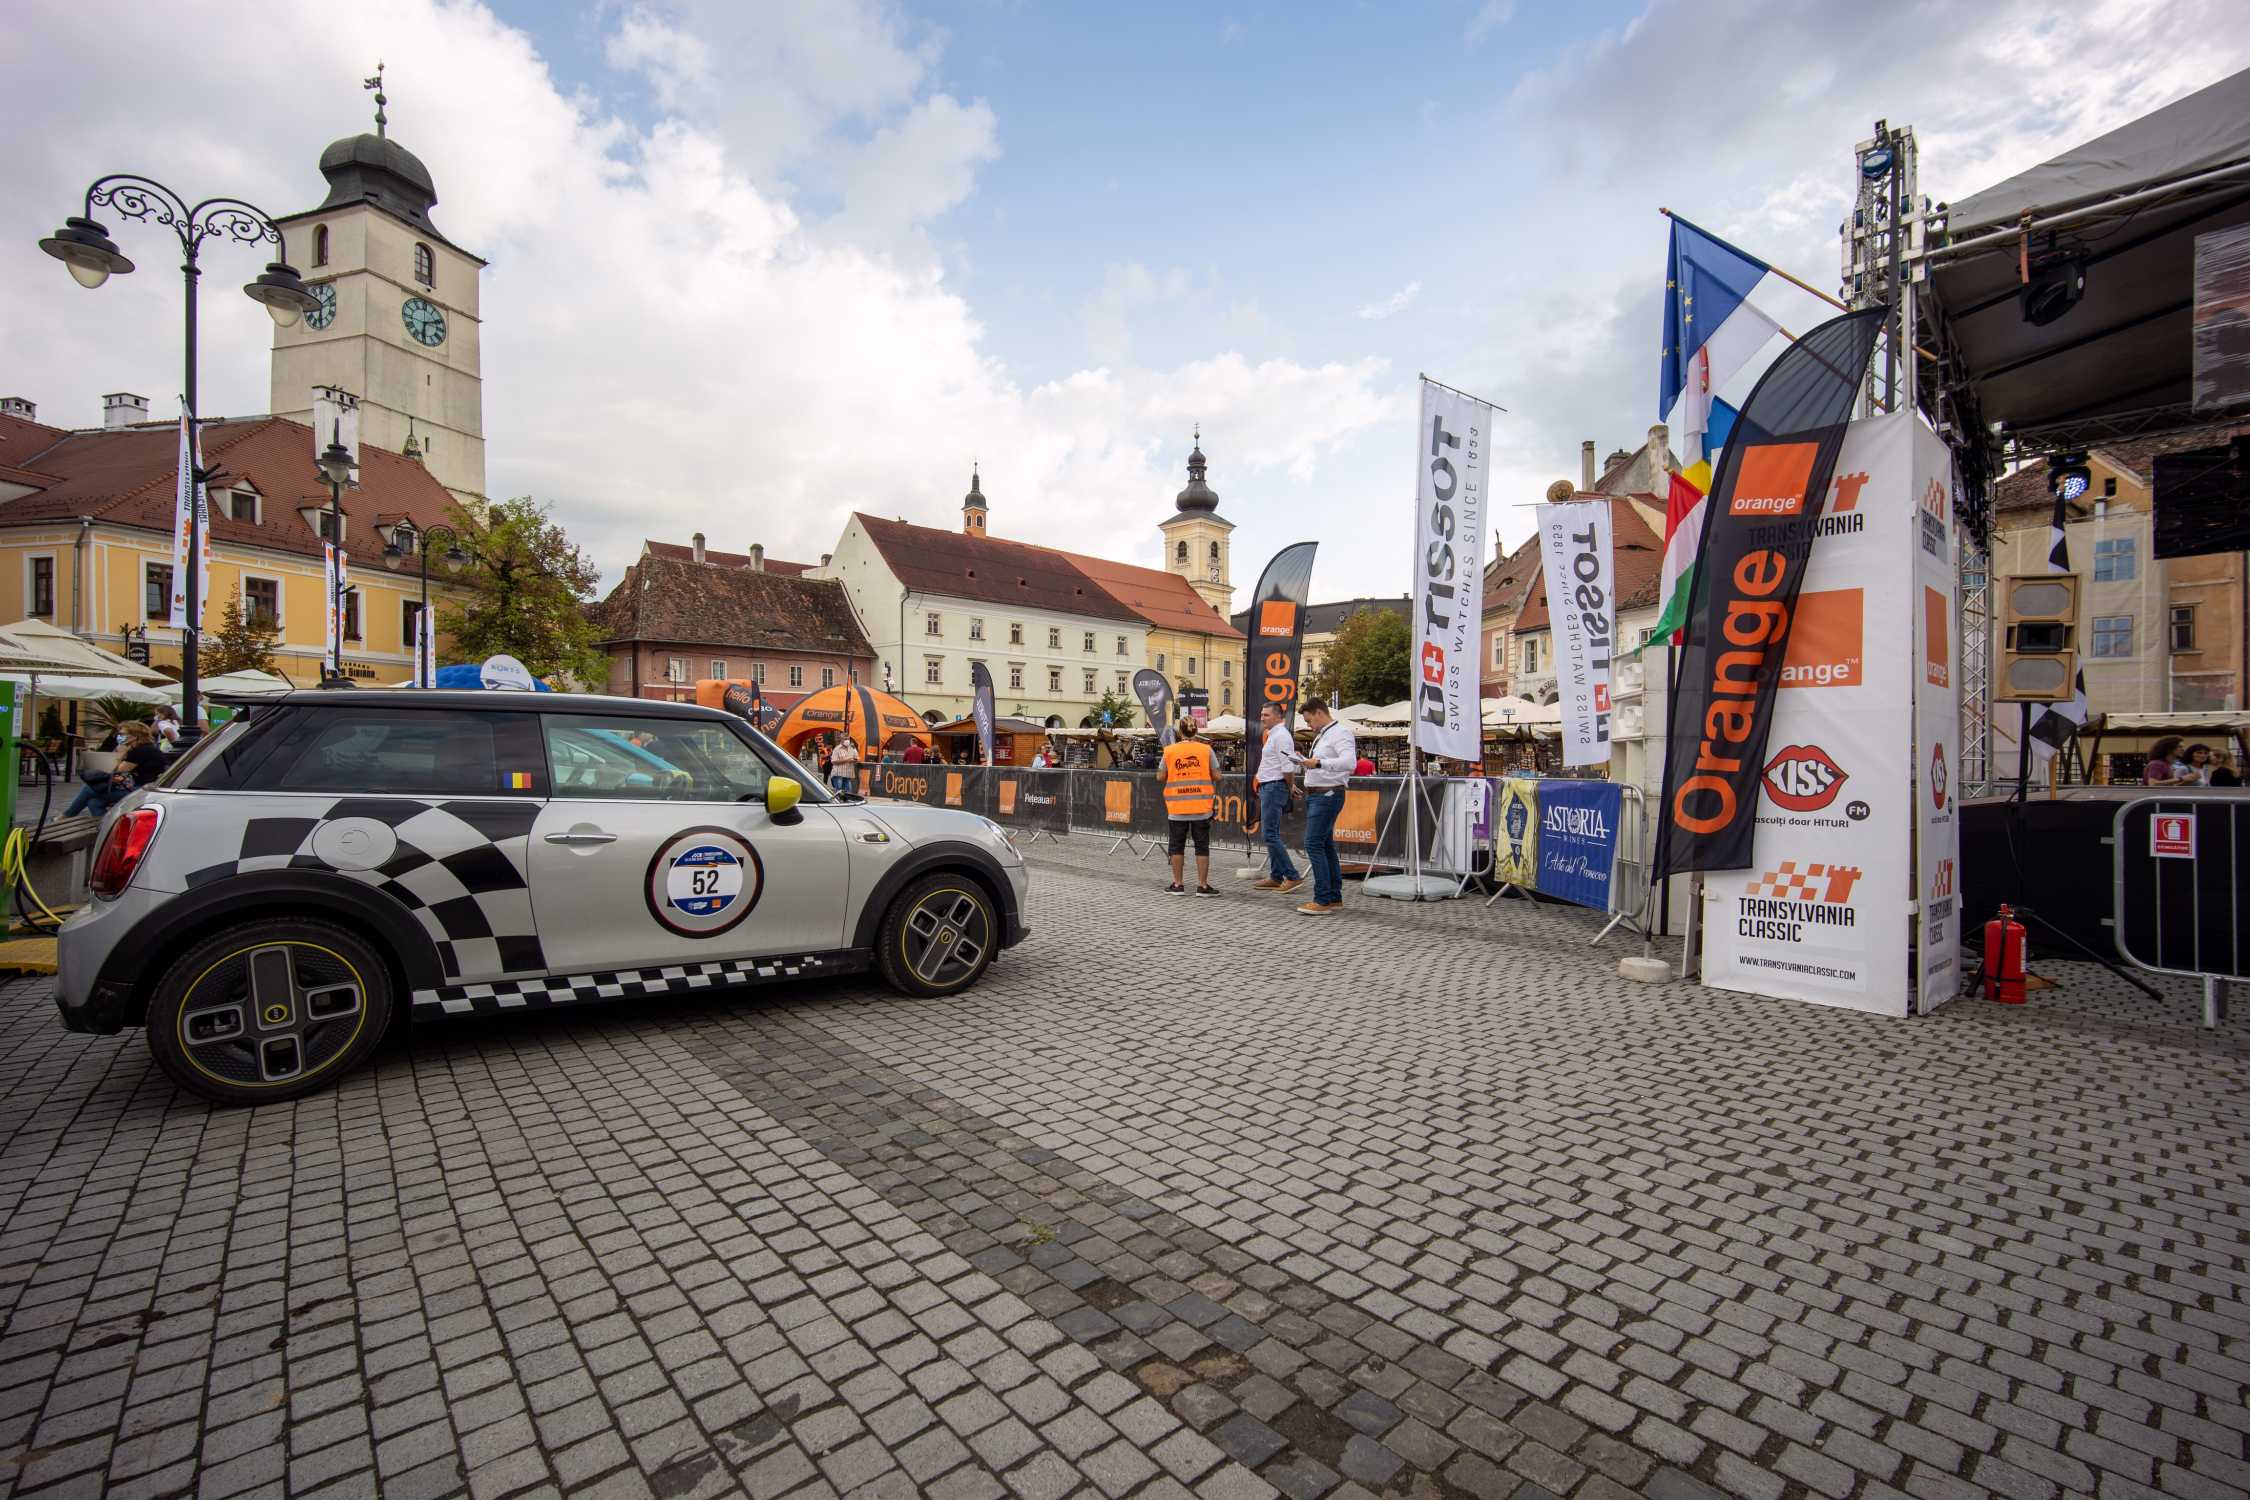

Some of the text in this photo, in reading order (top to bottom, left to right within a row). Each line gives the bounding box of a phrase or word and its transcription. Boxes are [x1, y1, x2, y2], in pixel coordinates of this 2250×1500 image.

[1735, 496, 1796, 513] orange
[1426, 415, 1460, 635] TISSOT
[1450, 427, 1478, 732] SWISS WATCHES SINCE 1853
[1261, 626, 1290, 635] orange
[1781, 663, 1849, 684] ange
[1673, 549, 1789, 835] Orange
[885, 770, 928, 801] Orange
[1768, 759, 1835, 796] KISS
[1543, 804, 1611, 839] ASTORIA
[1788, 817, 1812, 827] doar
[1813, 818, 1849, 828] HITURI
[1848, 806, 1867, 816] FM
[1335, 828, 1373, 842] orange
[693, 869, 719, 895] 52
[1739, 897, 1855, 927] TRANSYLVANIA
[1739, 918, 1802, 942] CLASSIC
[1739, 955, 1856, 981] WWW.TRANSYLVANIACLASSIC.COM
